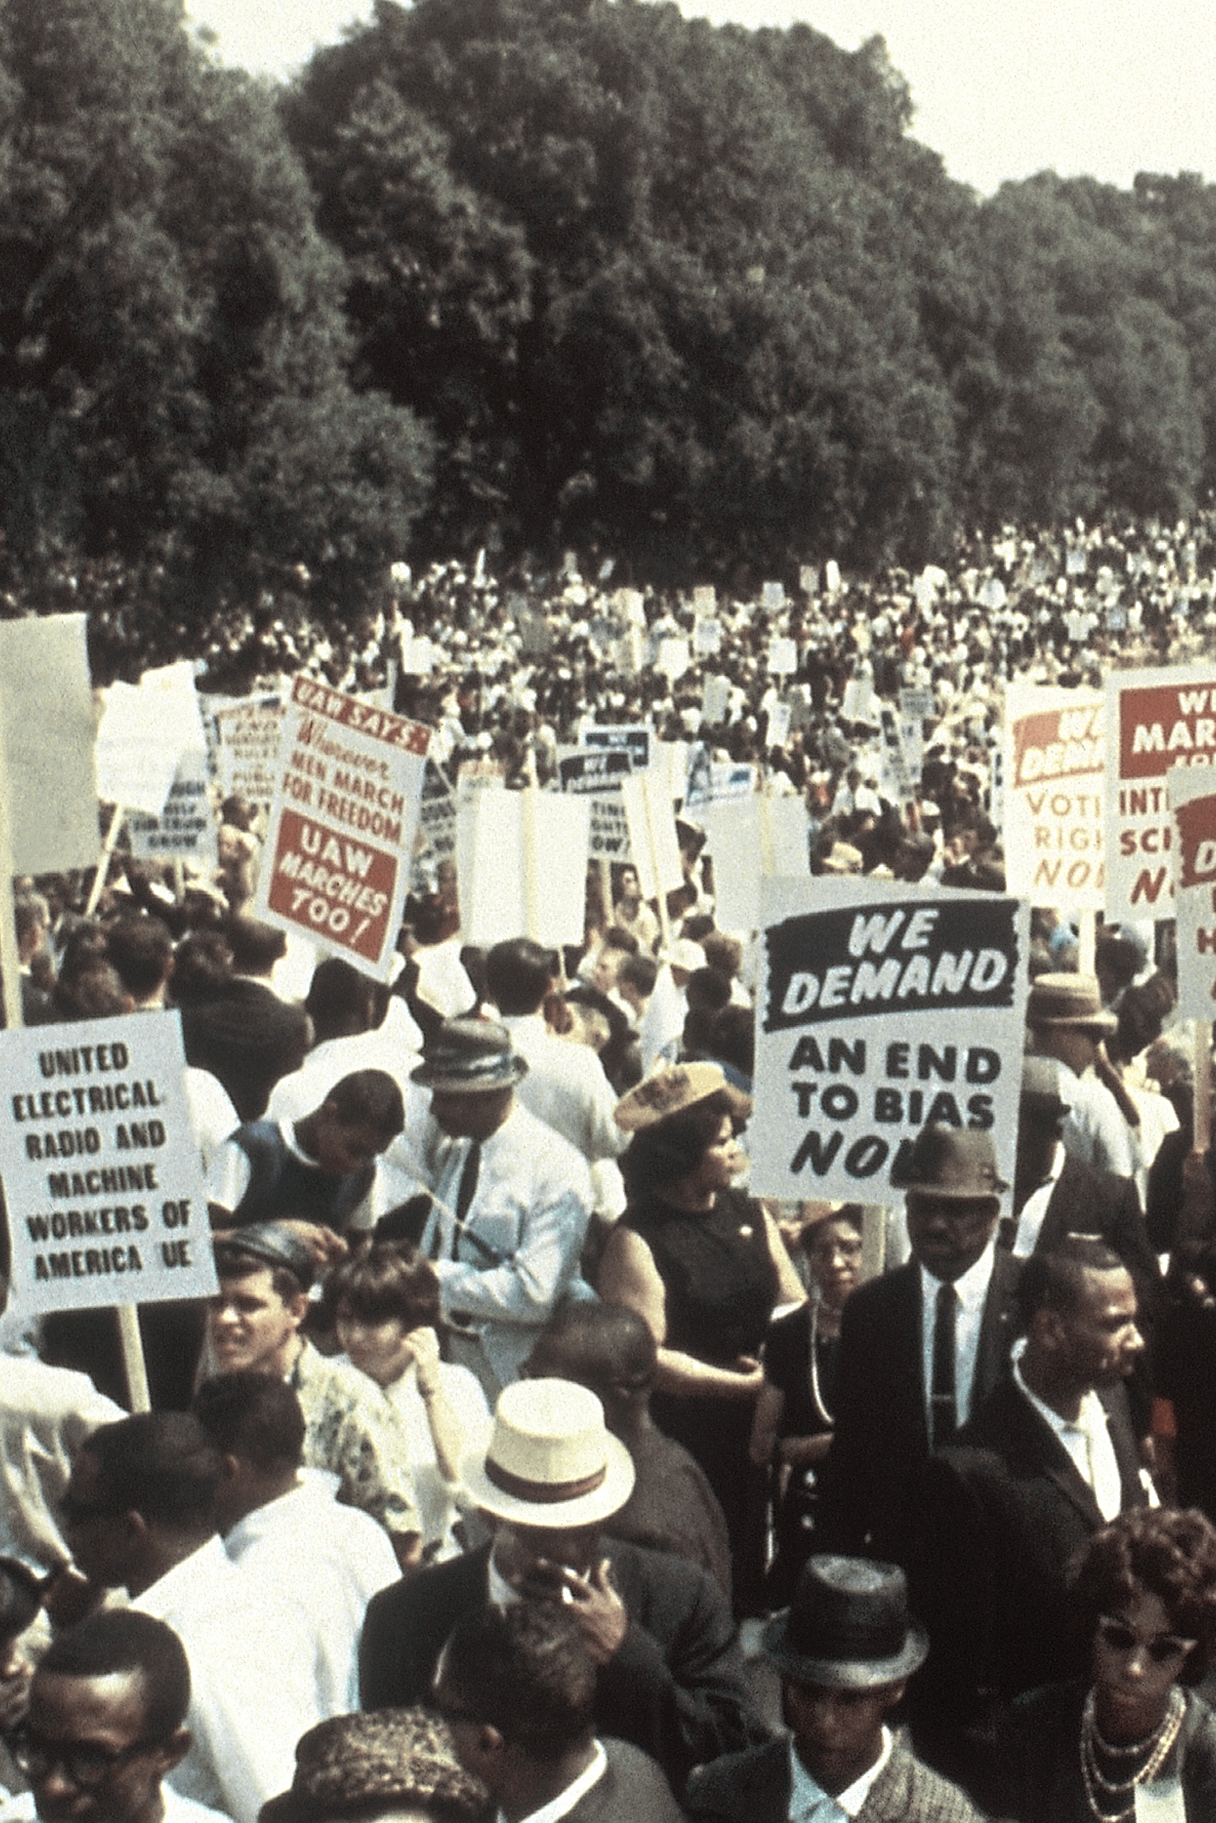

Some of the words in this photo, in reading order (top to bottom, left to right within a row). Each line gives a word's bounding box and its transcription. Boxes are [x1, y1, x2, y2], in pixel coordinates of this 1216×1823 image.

[297, 677, 345, 718] UAW
[282, 772, 313, 806] FOR
[317, 787, 403, 846] FREEDOM
[334, 768, 405, 818] MARCH
[1119, 786, 1169, 817] INT
[302, 825, 373, 878] UAW
[280, 849, 388, 917] MARCHES
[291, 888, 371, 944] TOO!
[848, 909, 940, 957] WE
[781, 949, 1008, 1015] DEMAND
[39, 1042, 129, 1079] UNITED
[788, 1035, 867, 1075] AN
[886, 1042, 1001, 1085] END
[11, 1079, 161, 1122] ELECTRICAL
[791, 1081, 859, 1121] TO
[874, 1087, 996, 1130] BIAS
[25, 1127, 101, 1160] RADIO
[116, 1119, 166, 1150] AND
[48, 1163, 159, 1198] MACHINE
[26, 1204, 150, 1242] WORKERS
[162, 1199, 192, 1228] OF
[34, 1245, 143, 1280] AMERICA
[161, 1240, 192, 1268] UE
